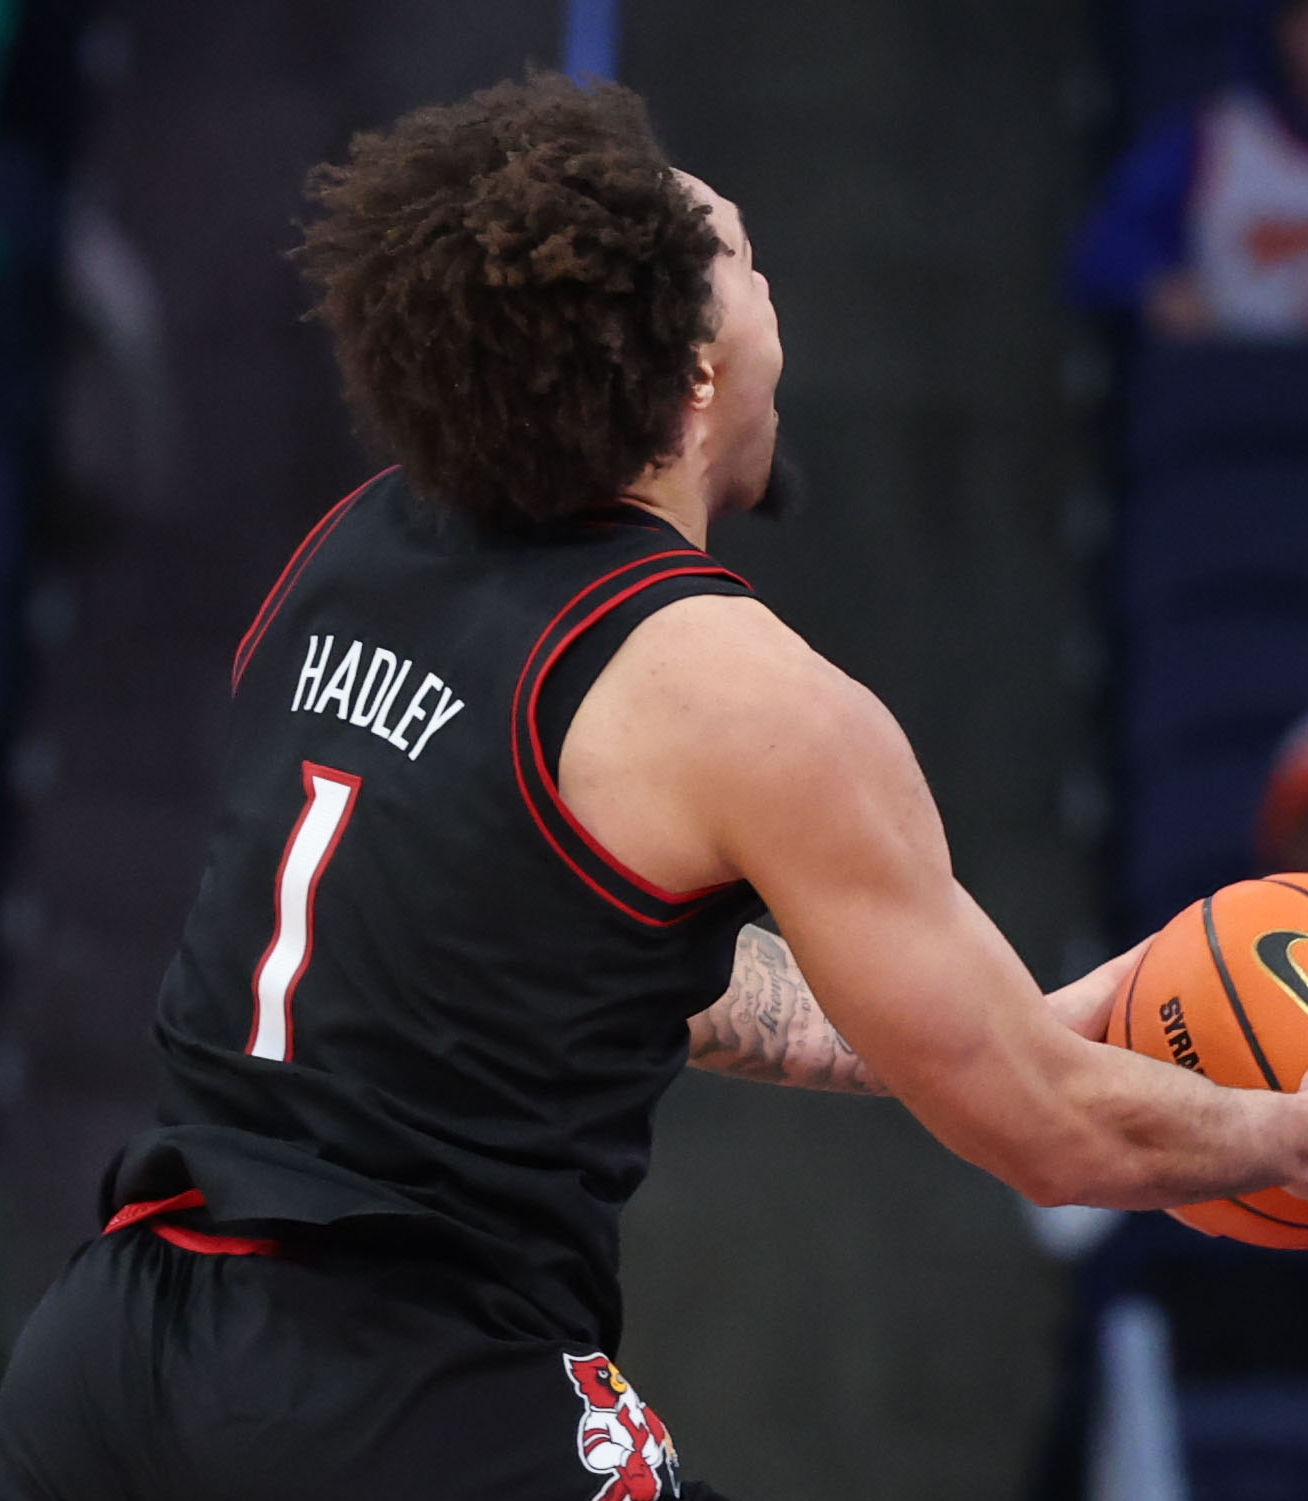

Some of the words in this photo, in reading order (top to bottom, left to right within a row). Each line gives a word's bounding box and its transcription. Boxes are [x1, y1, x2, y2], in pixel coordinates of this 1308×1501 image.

[291, 635, 465, 761] HADLEY
[245, 759, 362, 1062] 1
[1159, 995, 1206, 1077] SYRA
